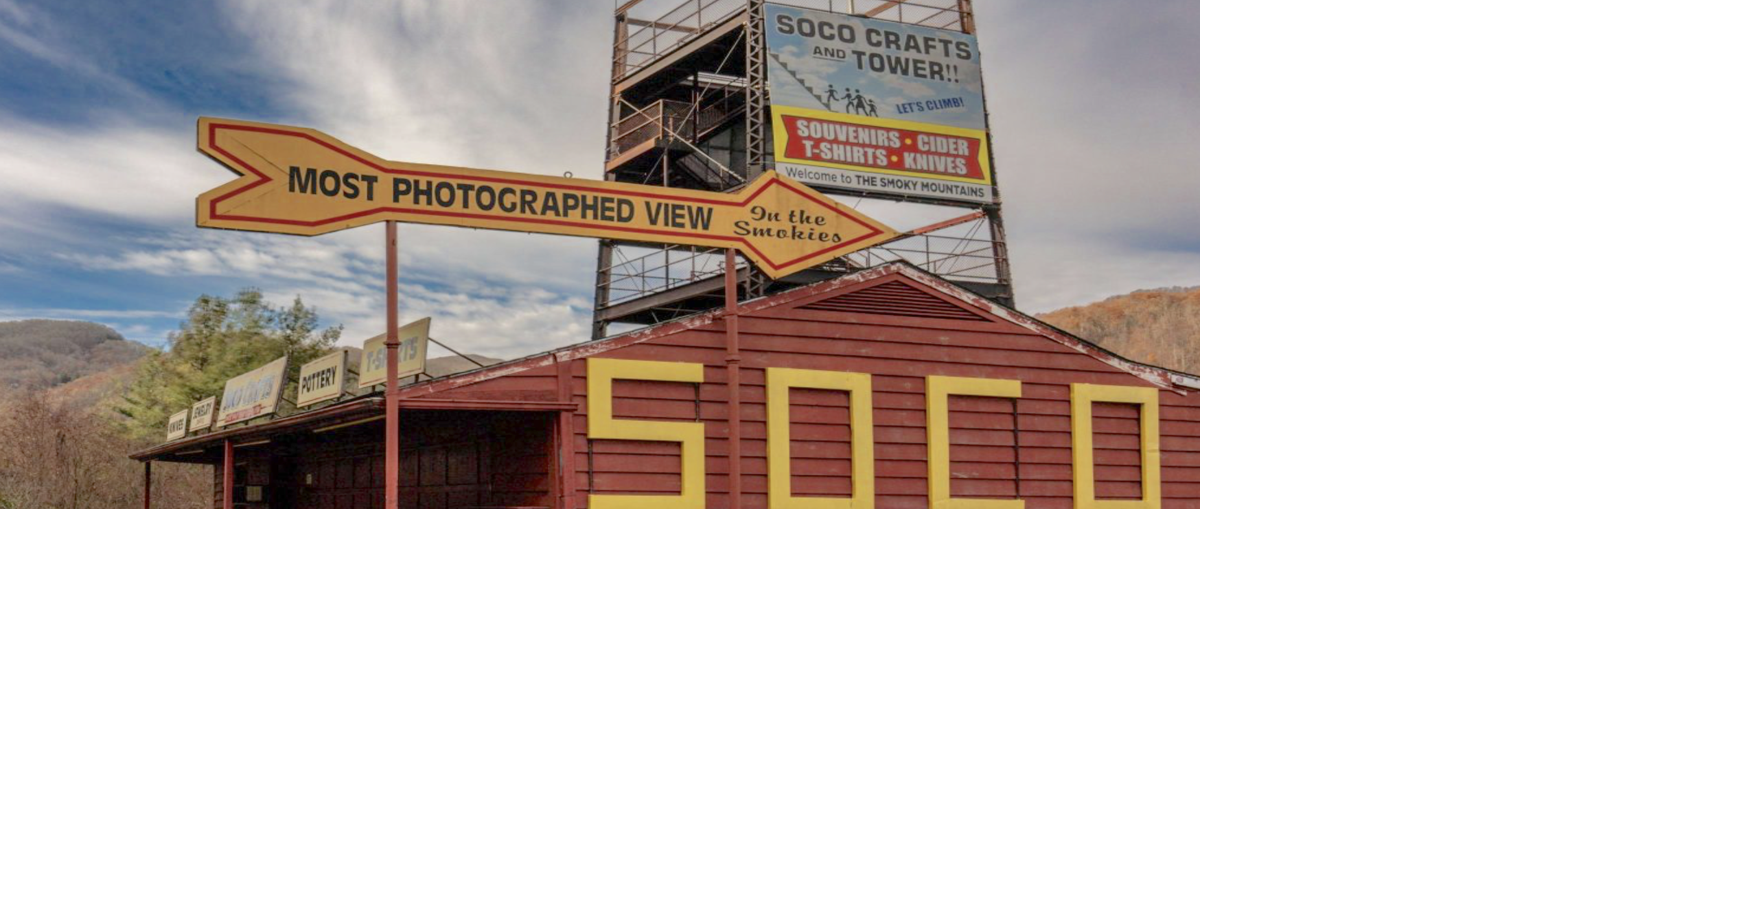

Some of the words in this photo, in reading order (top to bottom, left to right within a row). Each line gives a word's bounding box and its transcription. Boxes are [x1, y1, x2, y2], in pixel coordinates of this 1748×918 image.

[776, 14, 856, 44] SOCO
[865, 28, 972, 61] CRAFTS
[812, 45, 846, 59] AND
[852, 50, 959, 83] TOWER!!
[896, 101, 925, 114] LET'S
[926, 97, 965, 112] CLIMB!
[796, 119, 901, 148] SOUVENIRS
[917, 134, 969, 156] CIDER
[802, 140, 888, 166] T-SHIRTS
[903, 153, 968, 175] KNIVES
[288, 166, 378, 202] MOST
[392, 177, 635, 223] PHOTOGRAPHED
[645, 201, 713, 231] VIEW
[785, 166, 838, 183] Welcome
[840, 172, 852, 184] to
[855, 175, 878, 187] THE
[879, 177, 918, 192] SMOKY
[921, 180, 985, 198] MOUNTAINS
[733, 220, 842, 243] Smokies
[750, 205, 781, 222] In
[788, 209, 827, 226] the
[366, 337, 418, 372] T-SRTS
[301, 365, 337, 394] POTTERY
[587, 358, 1161, 509] SOCO
